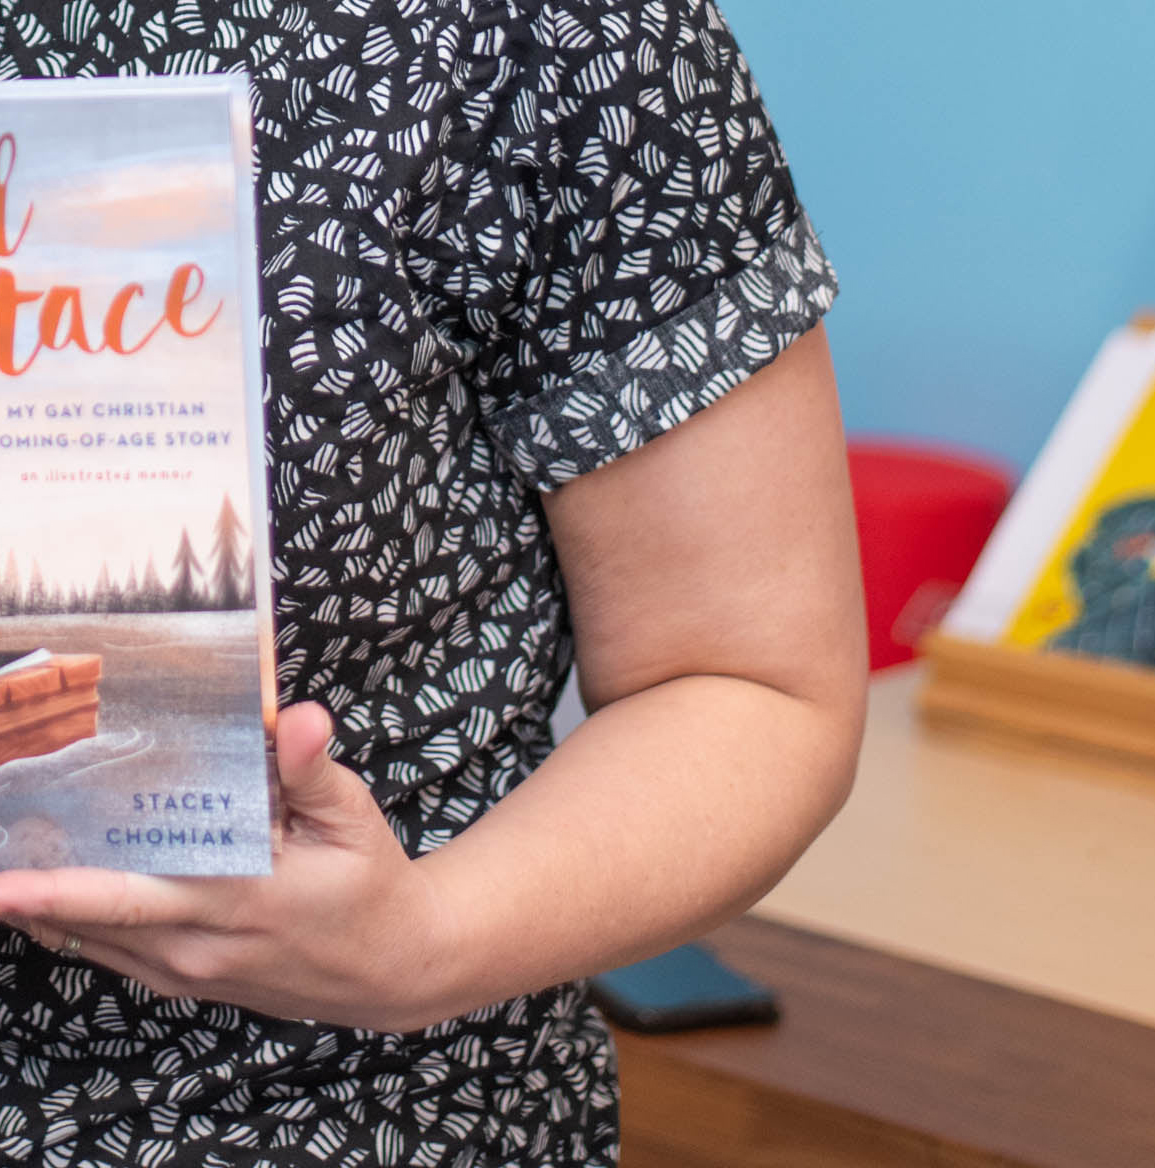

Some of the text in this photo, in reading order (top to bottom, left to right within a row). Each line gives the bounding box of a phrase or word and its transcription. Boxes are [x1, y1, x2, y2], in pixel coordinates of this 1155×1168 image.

[7, 402, 205, 419] MY GAY CHRISTIAN
[166, 431, 231, 446] STORY
[133, 793, 231, 810] STACEY
[106, 828, 234, 845] CHOMIAK
